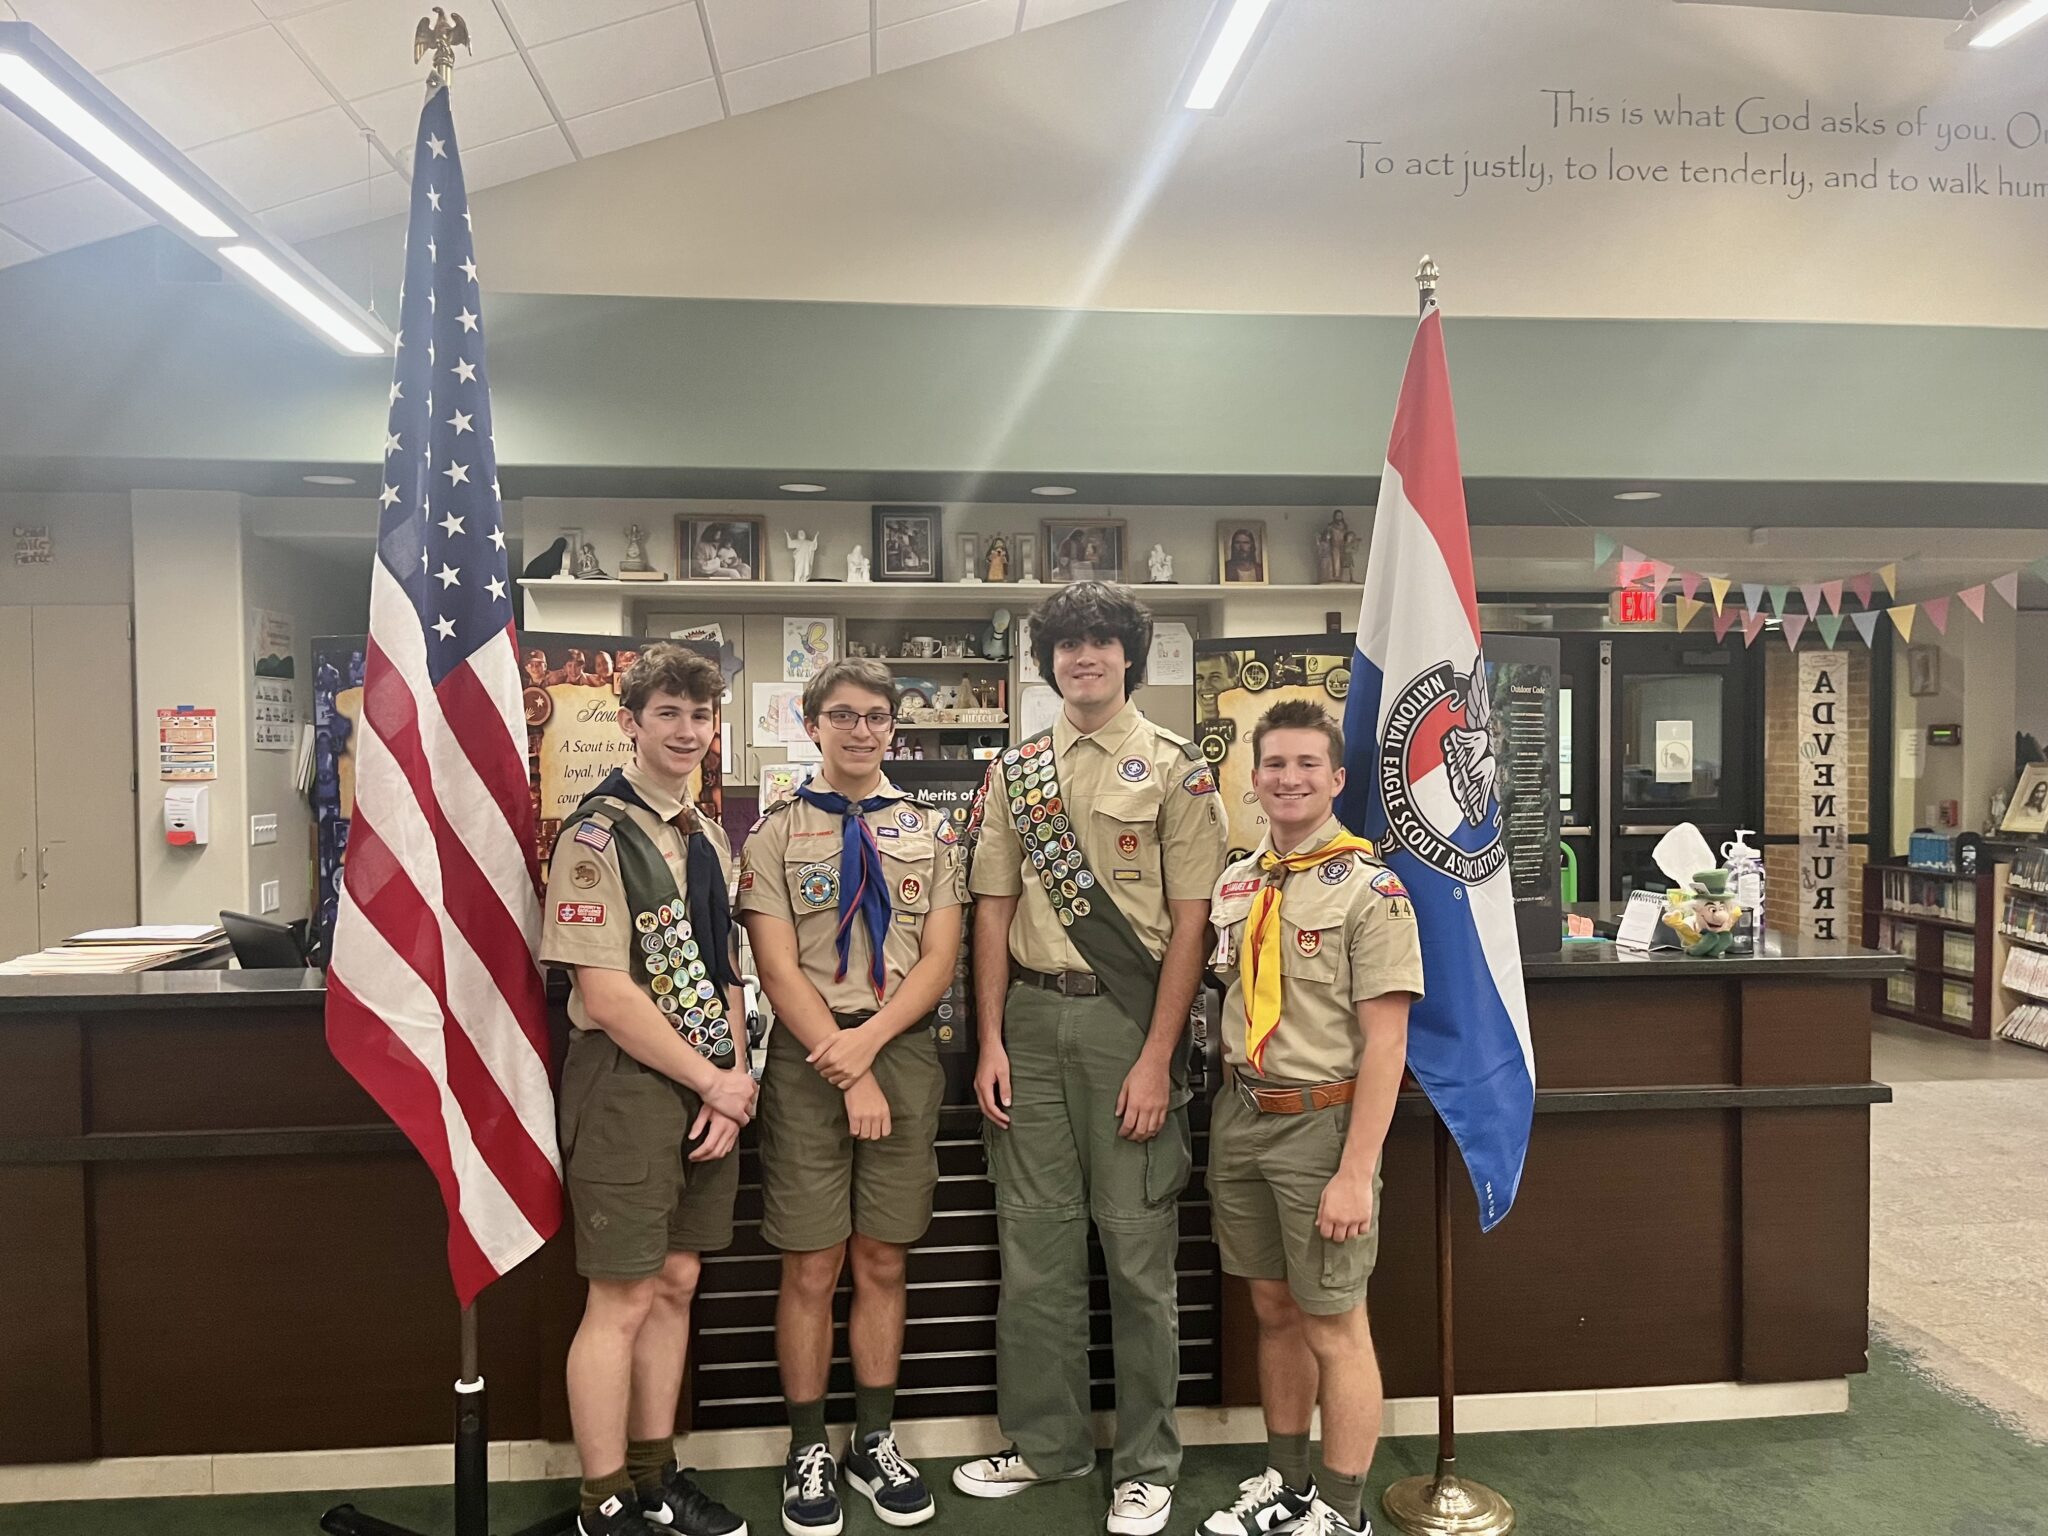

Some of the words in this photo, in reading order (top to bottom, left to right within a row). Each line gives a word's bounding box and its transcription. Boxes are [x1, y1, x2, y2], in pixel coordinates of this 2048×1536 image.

[1540, 89, 1610, 128] This
[1621, 98, 1643, 125] is
[1653, 93, 1726, 127] what
[1735, 96, 1810, 134] God
[1820, 102, 1886, 135] asks
[1896, 105, 1928, 136] of
[1934, 123, 1997, 152] you.
[2006, 111, 2048, 149] O
[1346, 140, 1394, 179] To
[1405, 153, 1454, 176] act
[1453, 144, 1553, 198] justly,
[1565, 157, 1597, 180] to
[1608, 147, 1668, 182] love
[1680, 151, 1813, 200] tenderly,
[1824, 157, 1878, 189] and
[1888, 168, 1918, 191] to
[1928, 162, 1989, 195] walk
[1621, 592, 1656, 621] EXIT
[1511, 685, 1532, 694] Outdoor
[1532, 686, 1545, 694] Code
[577, 699, 617, 722] Scou
[962, 713, 1000, 723] HIDEOUT
[1385, 673, 1446, 749] NATIONAL
[559, 740, 569, 752] A
[573, 740, 603, 752] Scout
[605, 740, 614, 752] is
[617, 742, 634, 752] tru
[917, 789, 957, 801] Merits
[960, 789, 974, 801] of
[1383, 756, 1406, 810] EAGLE
[1394, 811, 1447, 862] SCOUT
[1444, 839, 1506, 880] ASSOCIATION
